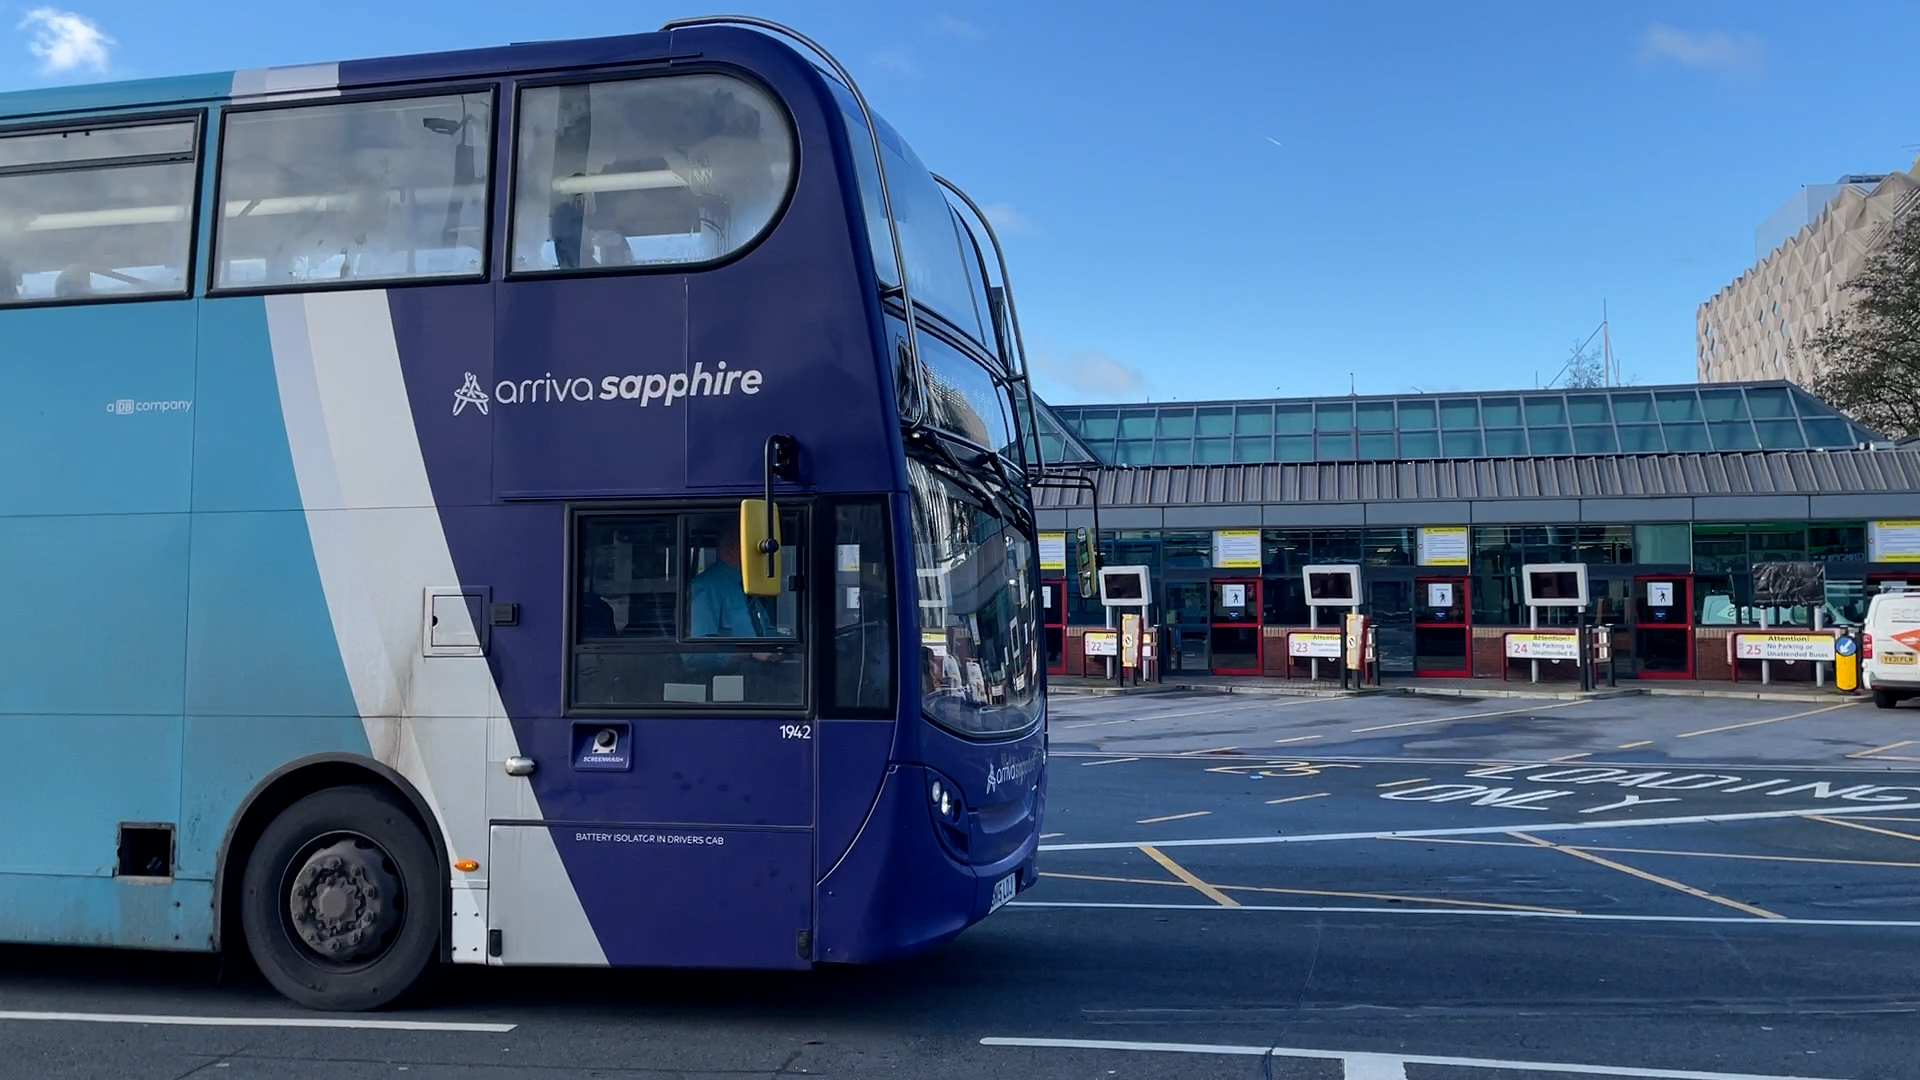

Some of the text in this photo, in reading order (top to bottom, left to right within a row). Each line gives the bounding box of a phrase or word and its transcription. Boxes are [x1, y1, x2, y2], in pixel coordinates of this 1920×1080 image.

[495, 361, 763, 407] arriva sapphire
[106, 400, 193, 413] a DB company
[1091, 641, 1102, 651] 22
[1296, 643, 1308, 653] 23
[1514, 643, 1528, 654] 24
[1746, 644, 1762, 655] 25
[780, 724, 811, 739] 1942
[1464, 763, 1920, 801] LOADING
[1380, 783, 1683, 814] ONLY
[575, 833, 724, 845] BATTERY ISOLATOR IN DRIVERS CAB
